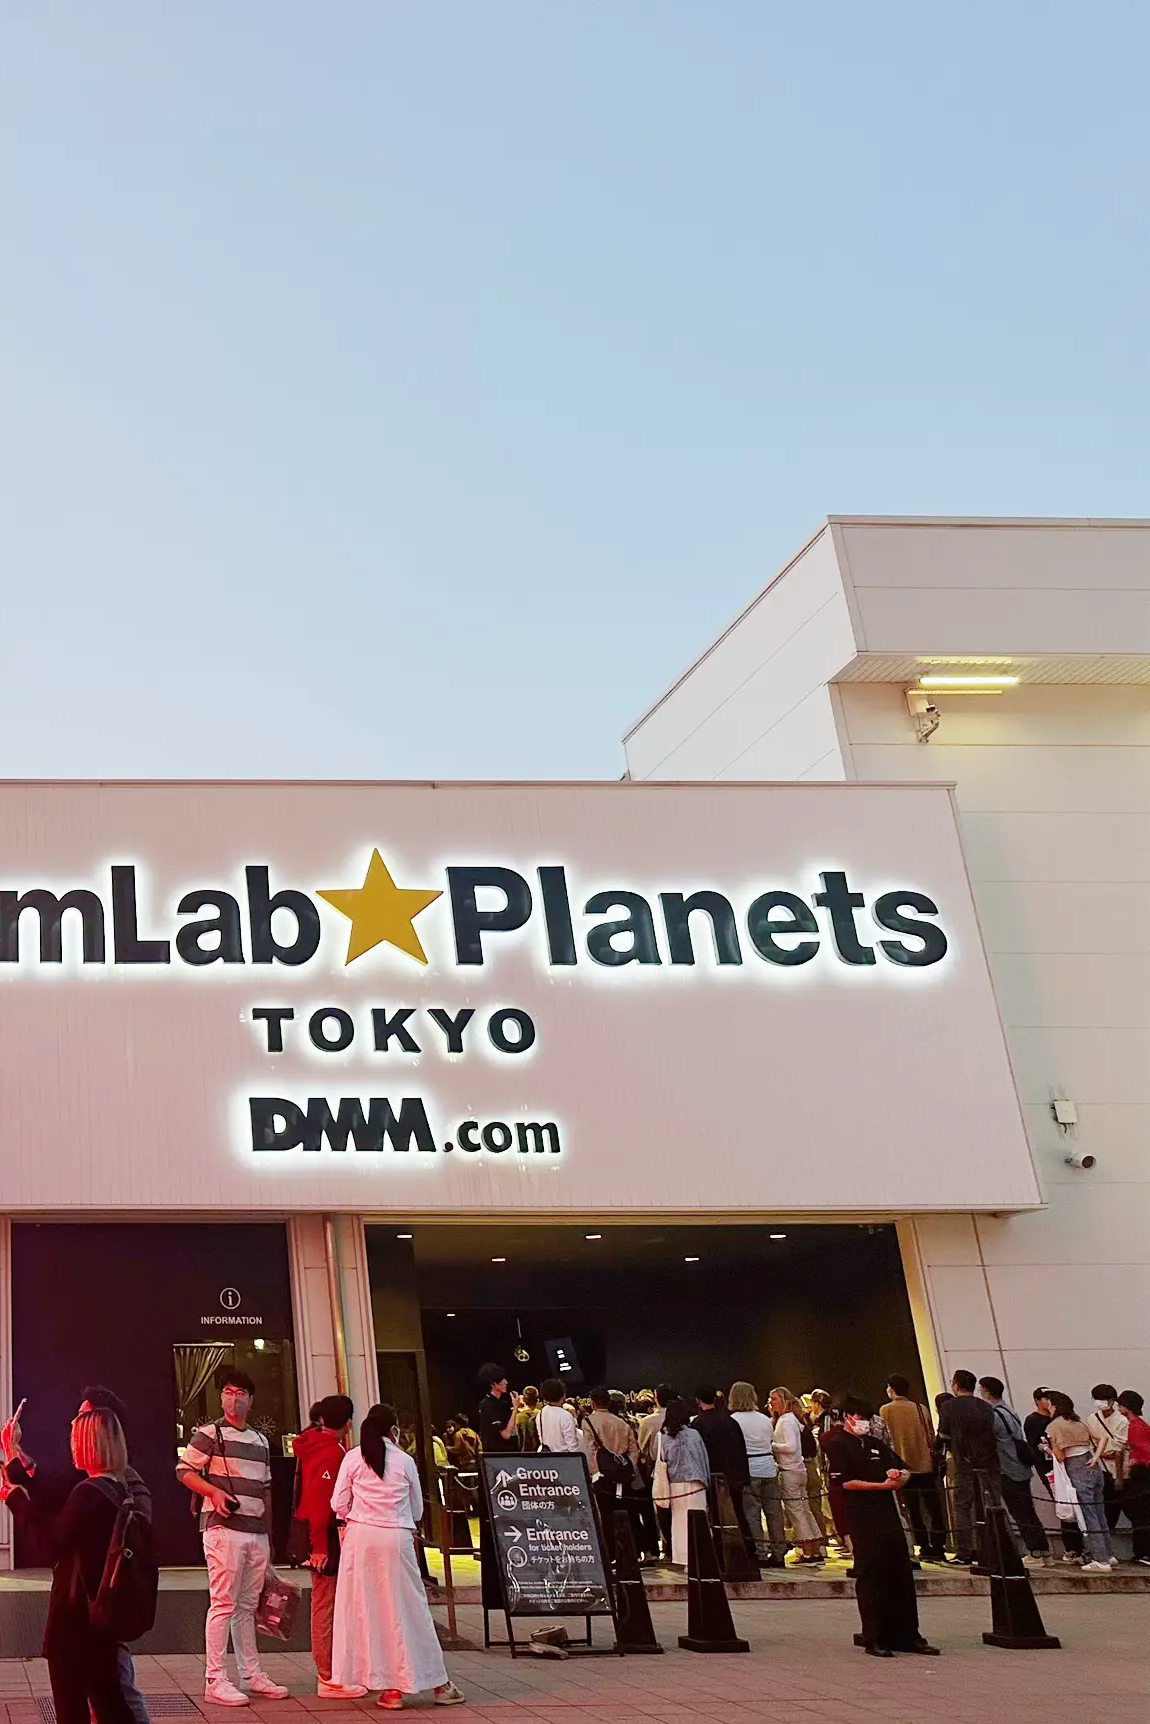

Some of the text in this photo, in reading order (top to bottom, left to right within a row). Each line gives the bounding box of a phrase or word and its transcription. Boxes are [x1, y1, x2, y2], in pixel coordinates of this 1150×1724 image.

[445, 865, 948, 968] Planets
[252, 1007, 536, 1054] TOKYO
[249, 1097, 562, 1153] DMM.com
[200, 1316, 263, 1325] INFORMATION
[516, 1467, 559, 1482] Group
[518, 1483, 581, 1496] Entrance
[521, 1500, 555, 1510] 団体の方
[526, 1528, 589, 1540] Entrance
[529, 1543, 593, 1551] for ticket holders
